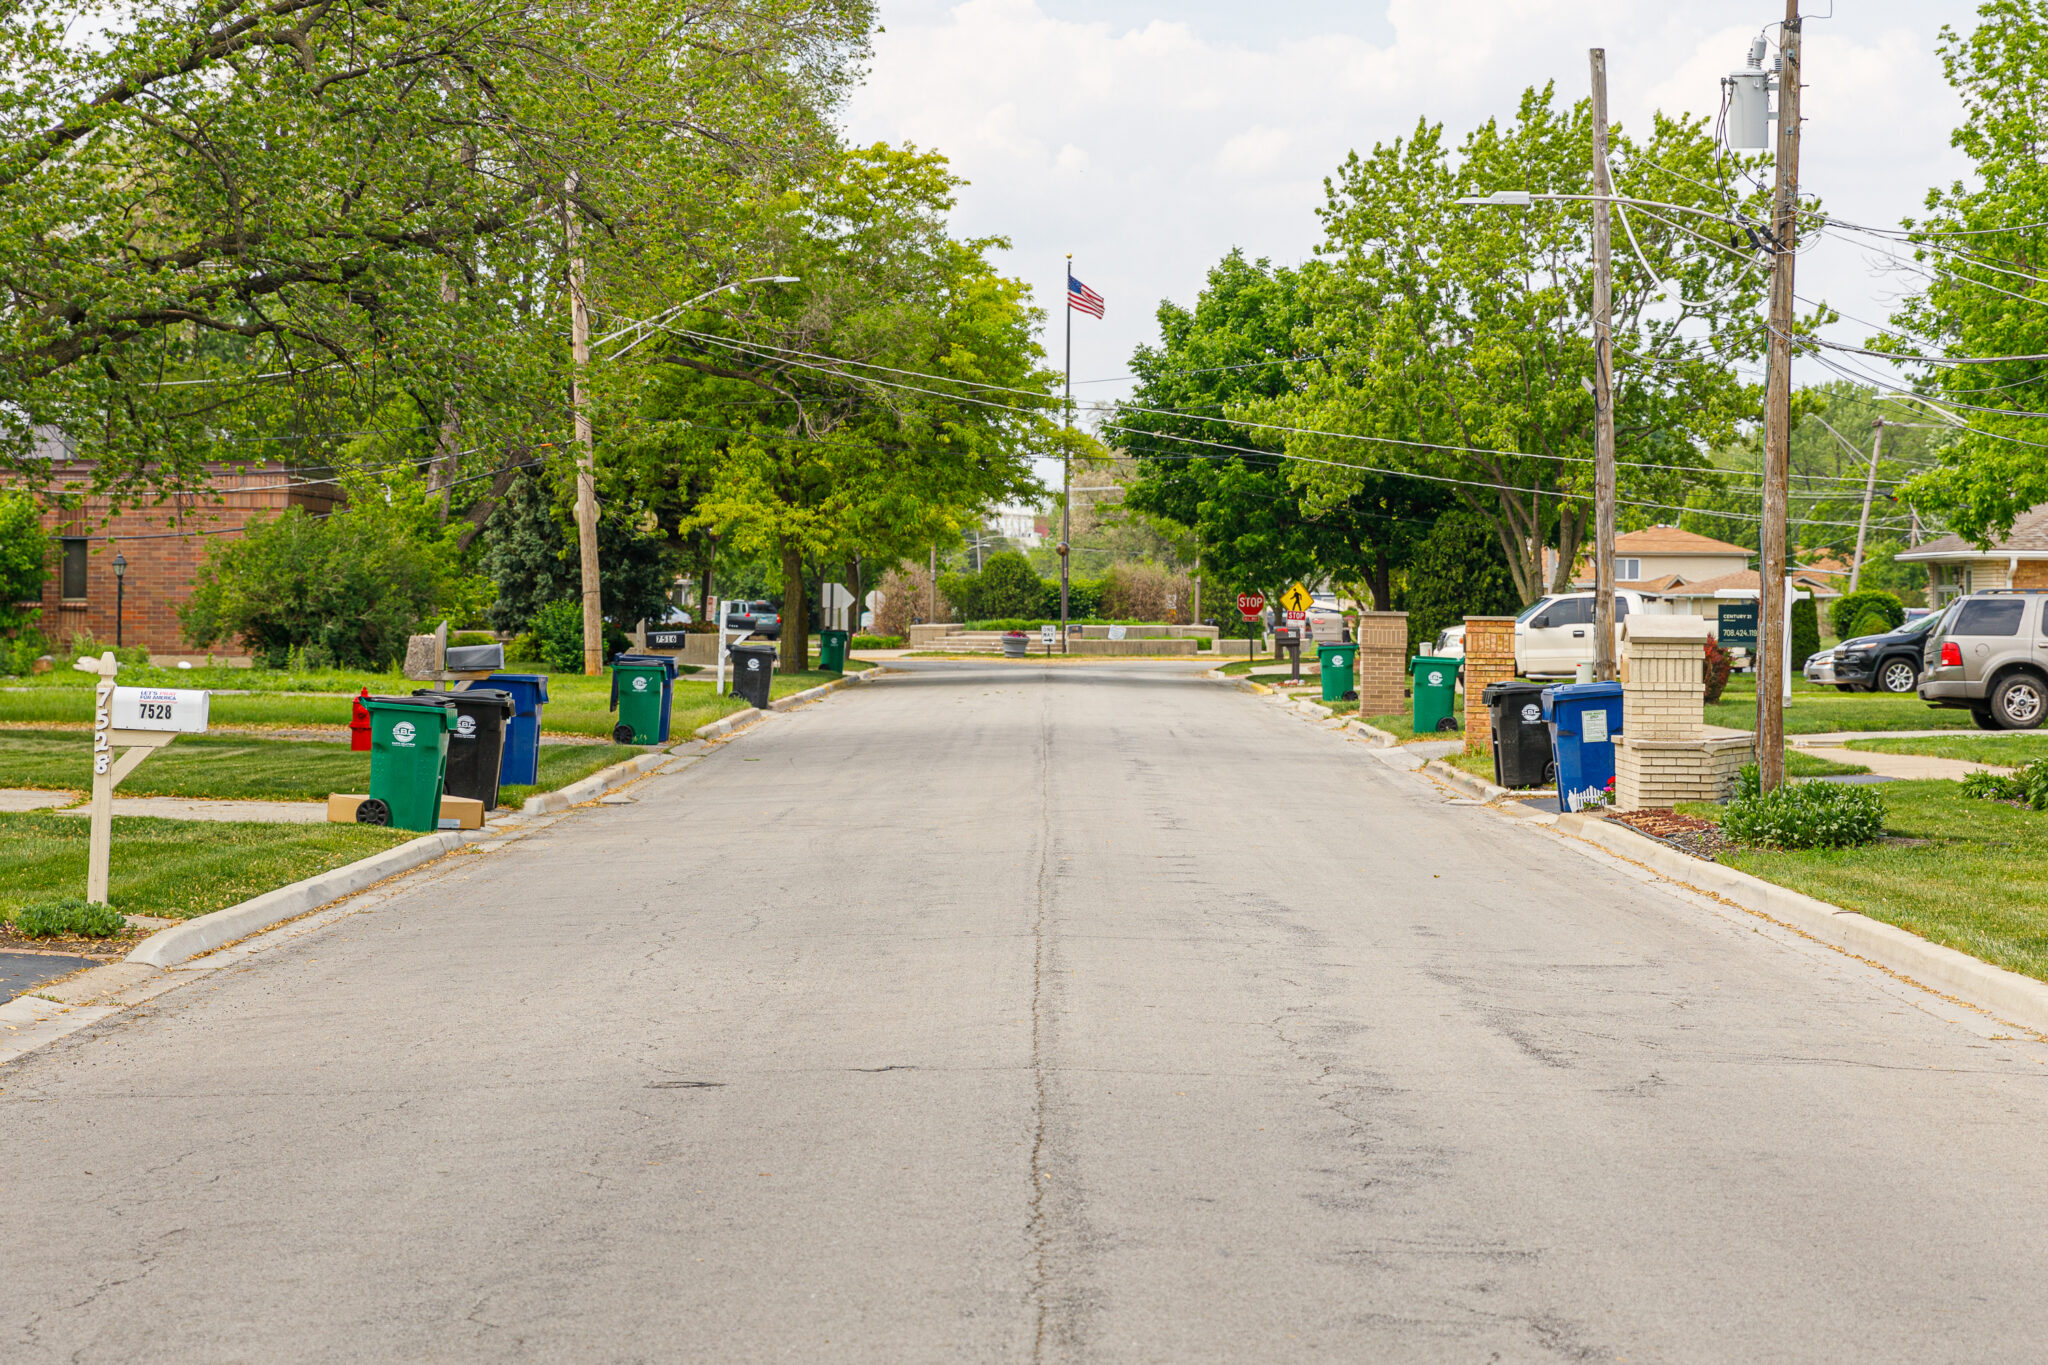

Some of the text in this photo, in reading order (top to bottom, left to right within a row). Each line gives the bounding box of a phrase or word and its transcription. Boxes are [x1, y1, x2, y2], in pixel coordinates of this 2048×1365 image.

[1239, 596, 1263, 608] STOP
[1288, 612, 1304, 620] STOP
[656, 635, 676, 643] 7516
[140, 703, 172, 719] 7528
[95, 687, 112, 774] 7528
